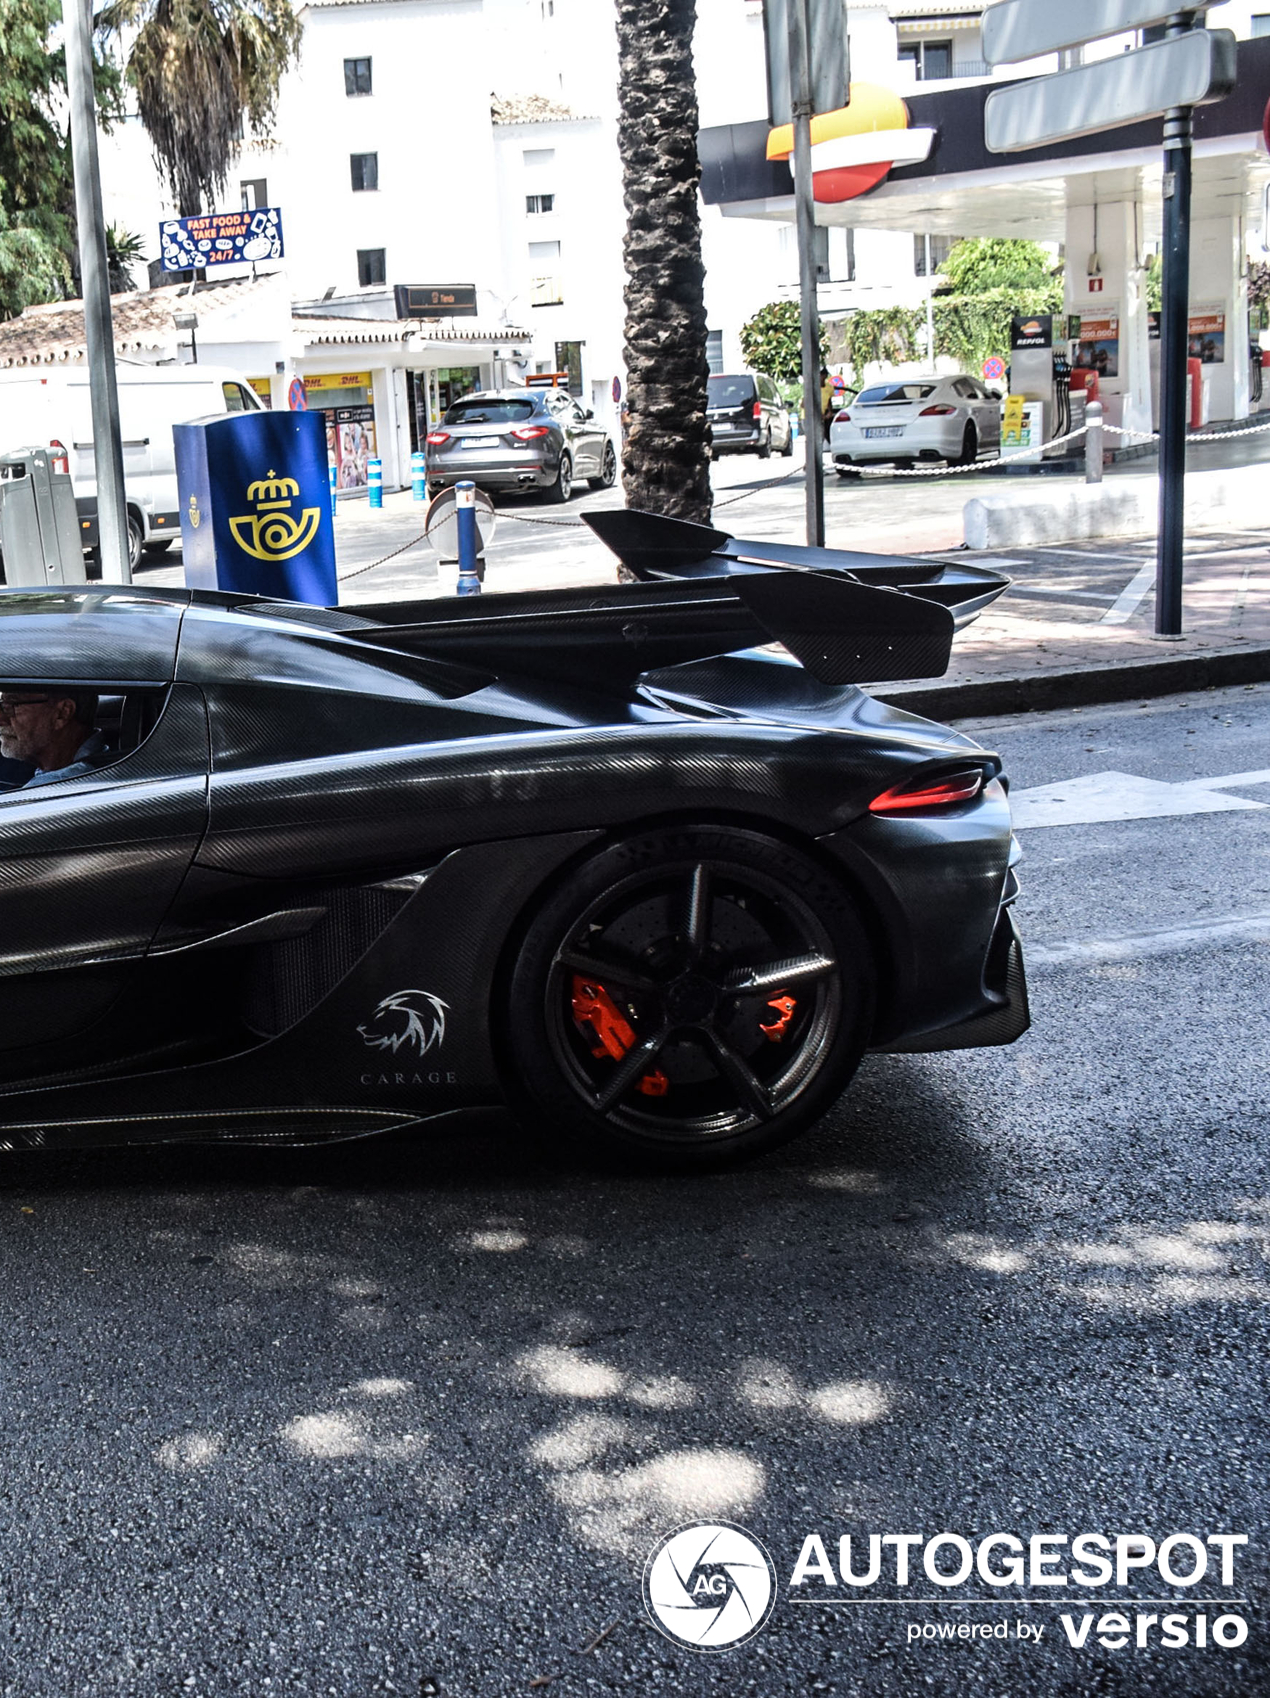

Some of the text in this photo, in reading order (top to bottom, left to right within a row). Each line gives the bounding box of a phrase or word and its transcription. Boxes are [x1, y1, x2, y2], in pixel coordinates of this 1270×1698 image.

[187, 213, 251, 231] FAST FOOD &
[192, 225, 247, 240] TAKE AWAY
[209, 249, 234, 263] 24/7
[1016, 337, 1045, 346] REPSOL
[340, 375, 361, 385] DHL
[360, 1072, 458, 1086] CARAGE
